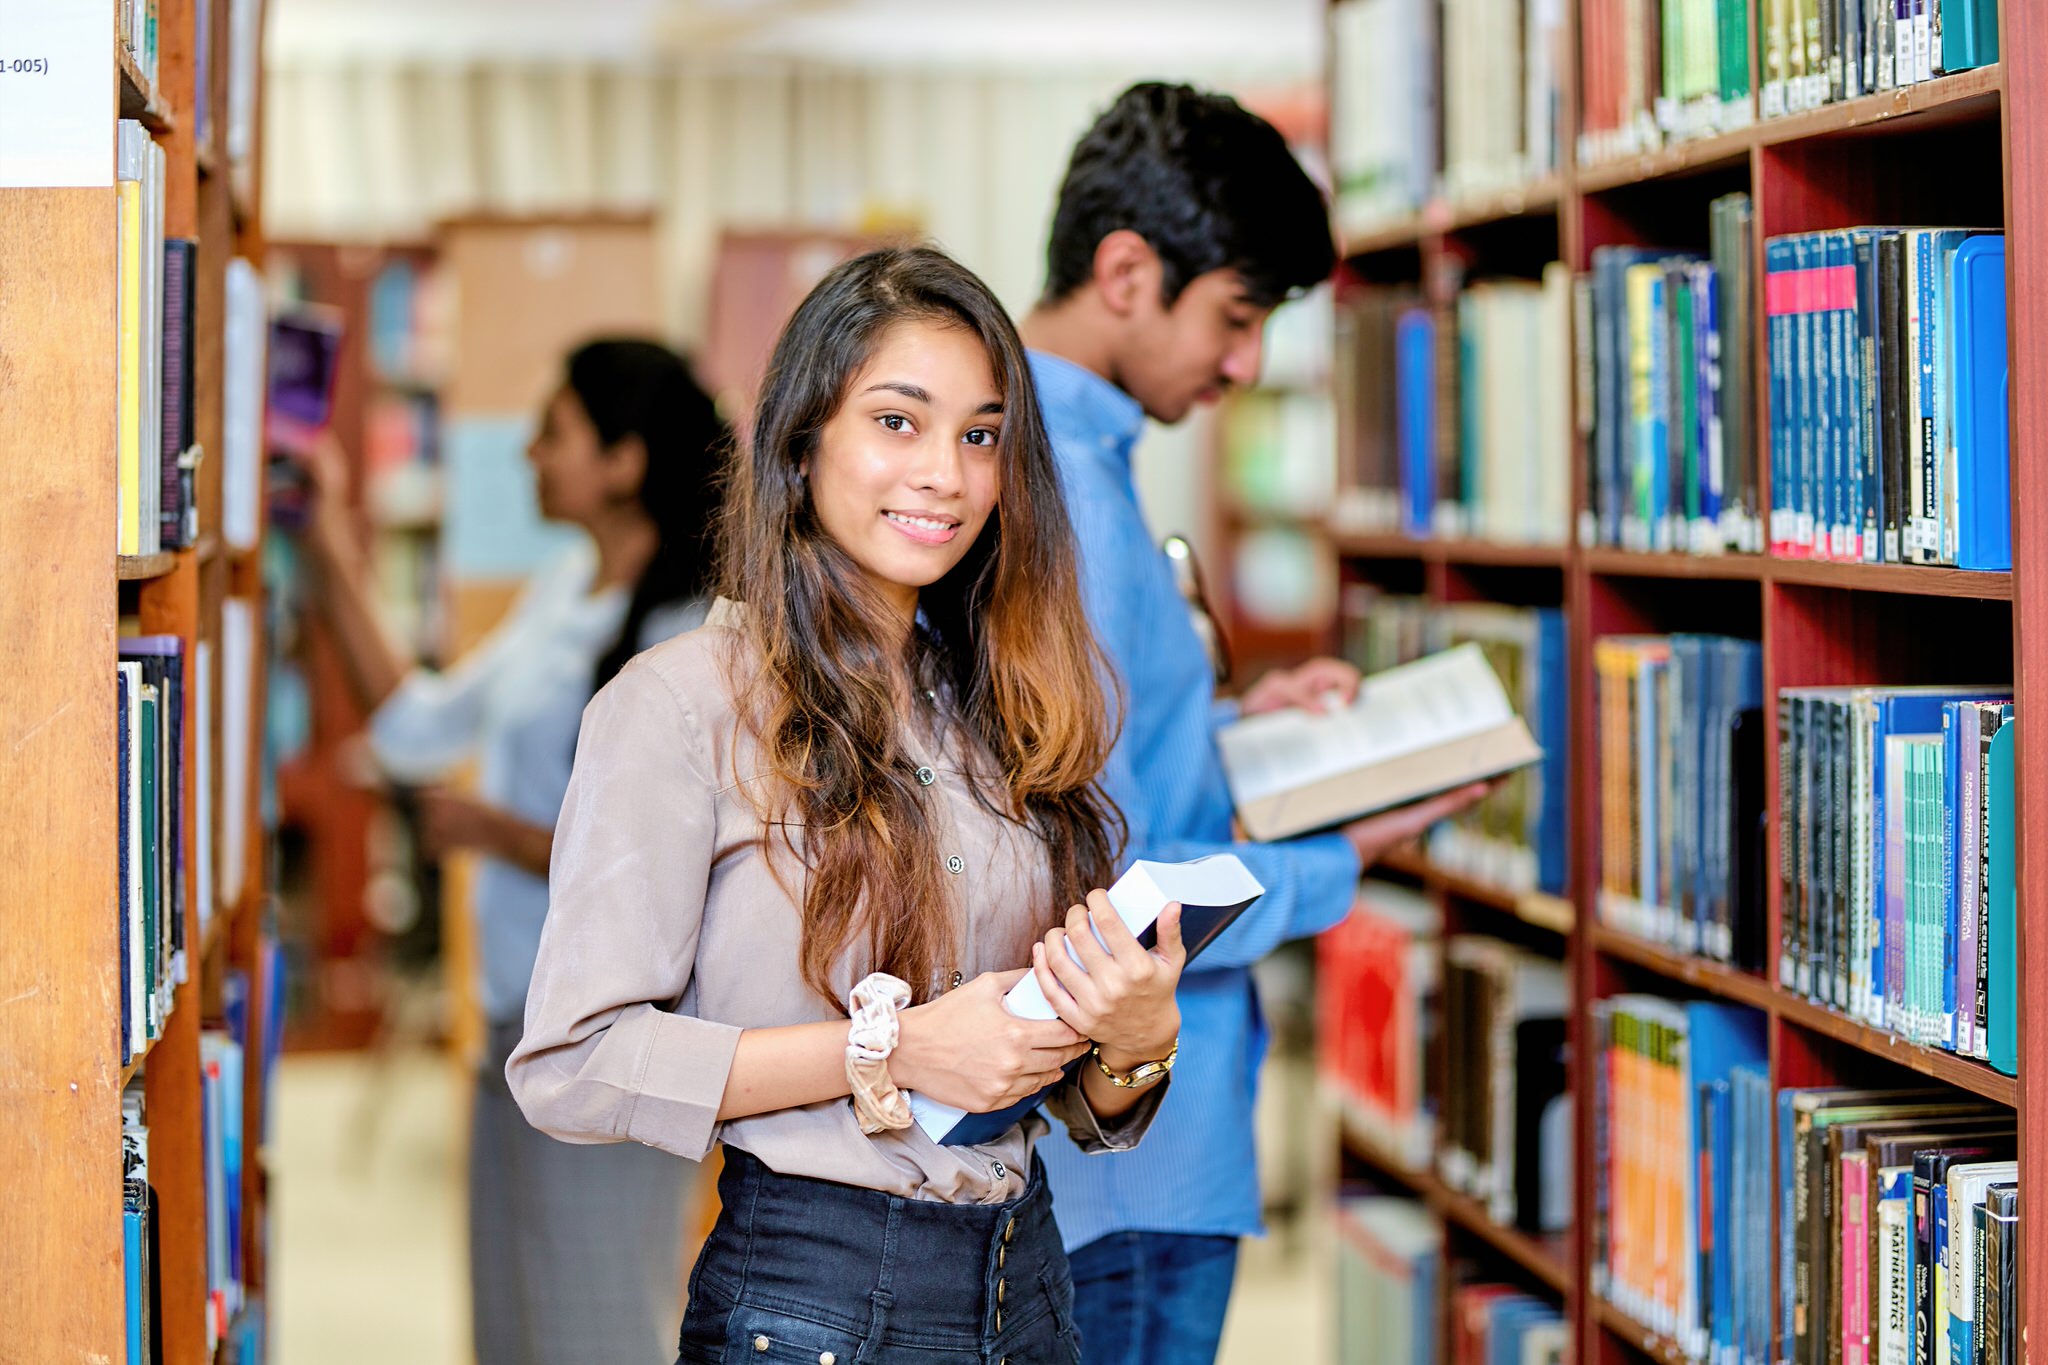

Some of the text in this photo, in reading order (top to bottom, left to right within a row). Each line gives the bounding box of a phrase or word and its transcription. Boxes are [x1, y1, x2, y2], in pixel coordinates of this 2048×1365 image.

[0, 57, 48, 76] 1-005)
[1982, 864, 1989, 888] OF
[1891, 1224, 1899, 1331] MATHEMATICS
